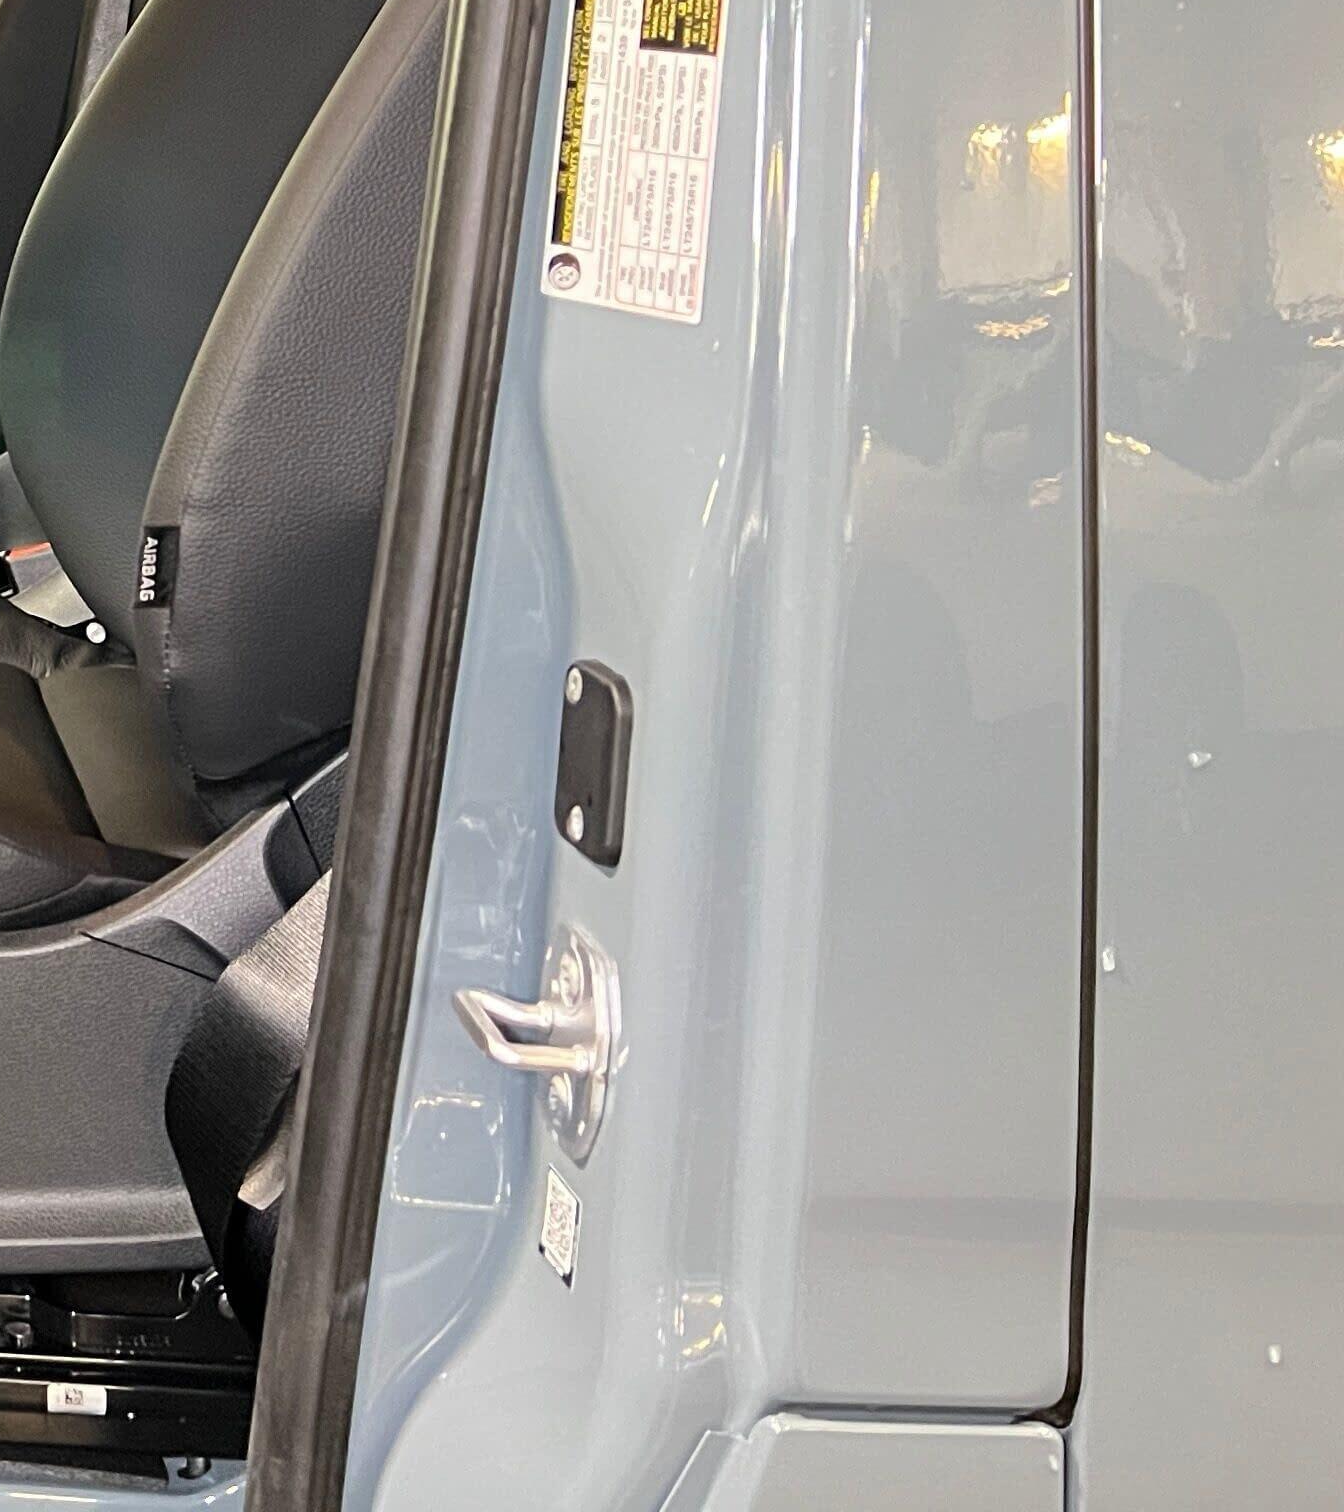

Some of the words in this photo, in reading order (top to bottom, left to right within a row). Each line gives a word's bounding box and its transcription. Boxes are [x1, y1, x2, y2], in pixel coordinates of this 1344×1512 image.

[568, 9, 583, 81] INFORMATION
[563, 87, 576, 134] LOADING
[573, 104, 583, 124] LES
[560, 140, 570, 164] AND
[570, 127, 581, 147] SUR
[140, 536, 158, 601] AIRBAG
